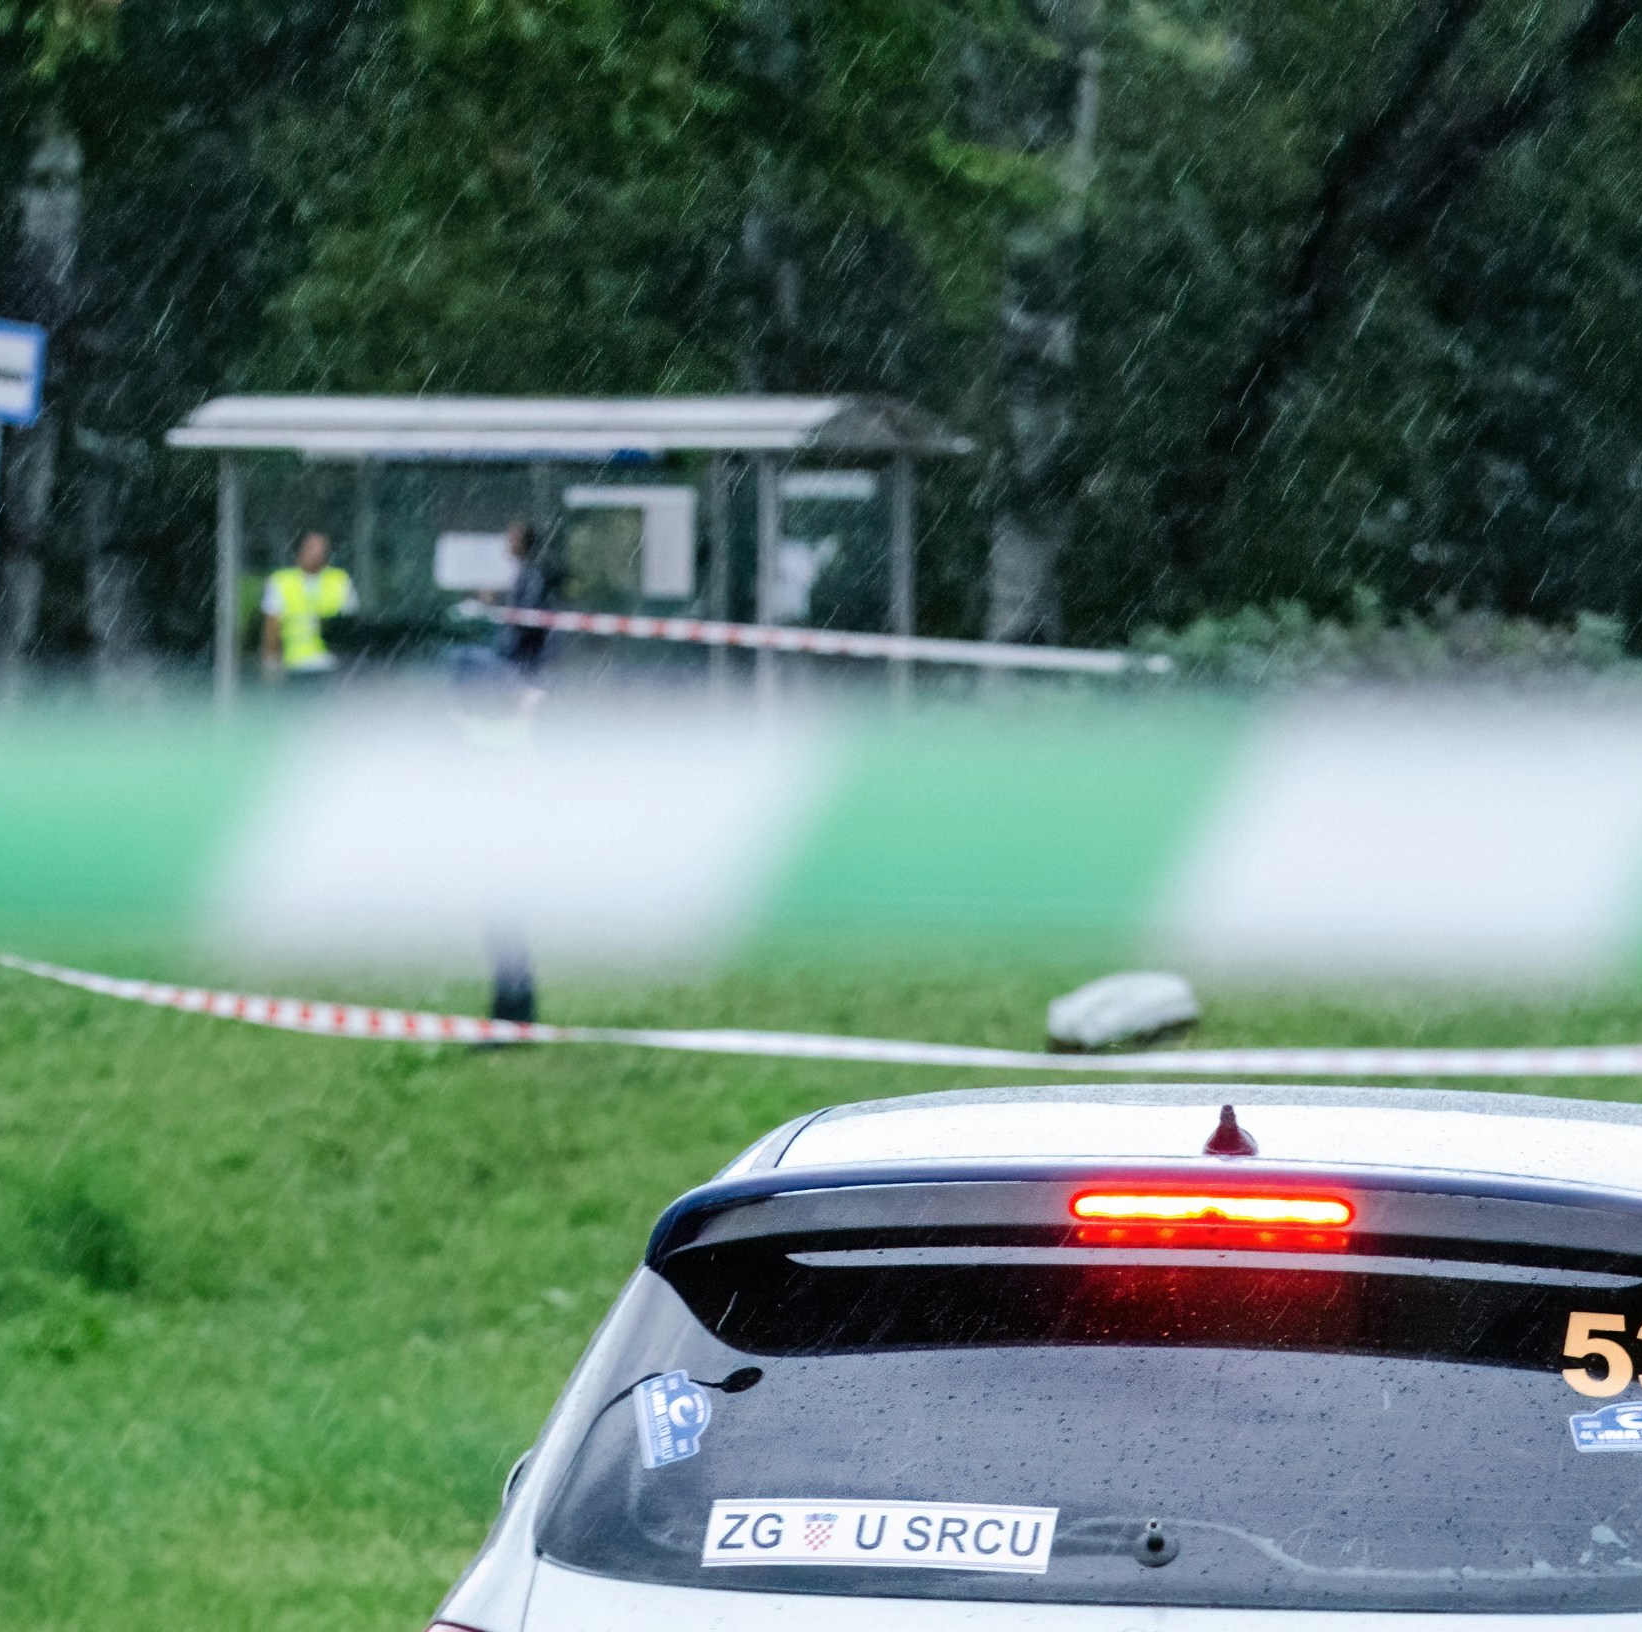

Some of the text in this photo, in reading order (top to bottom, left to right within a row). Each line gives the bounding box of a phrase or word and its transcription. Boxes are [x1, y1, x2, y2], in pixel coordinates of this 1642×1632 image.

[717, 1513, 1042, 1556] ZG U SRCU
